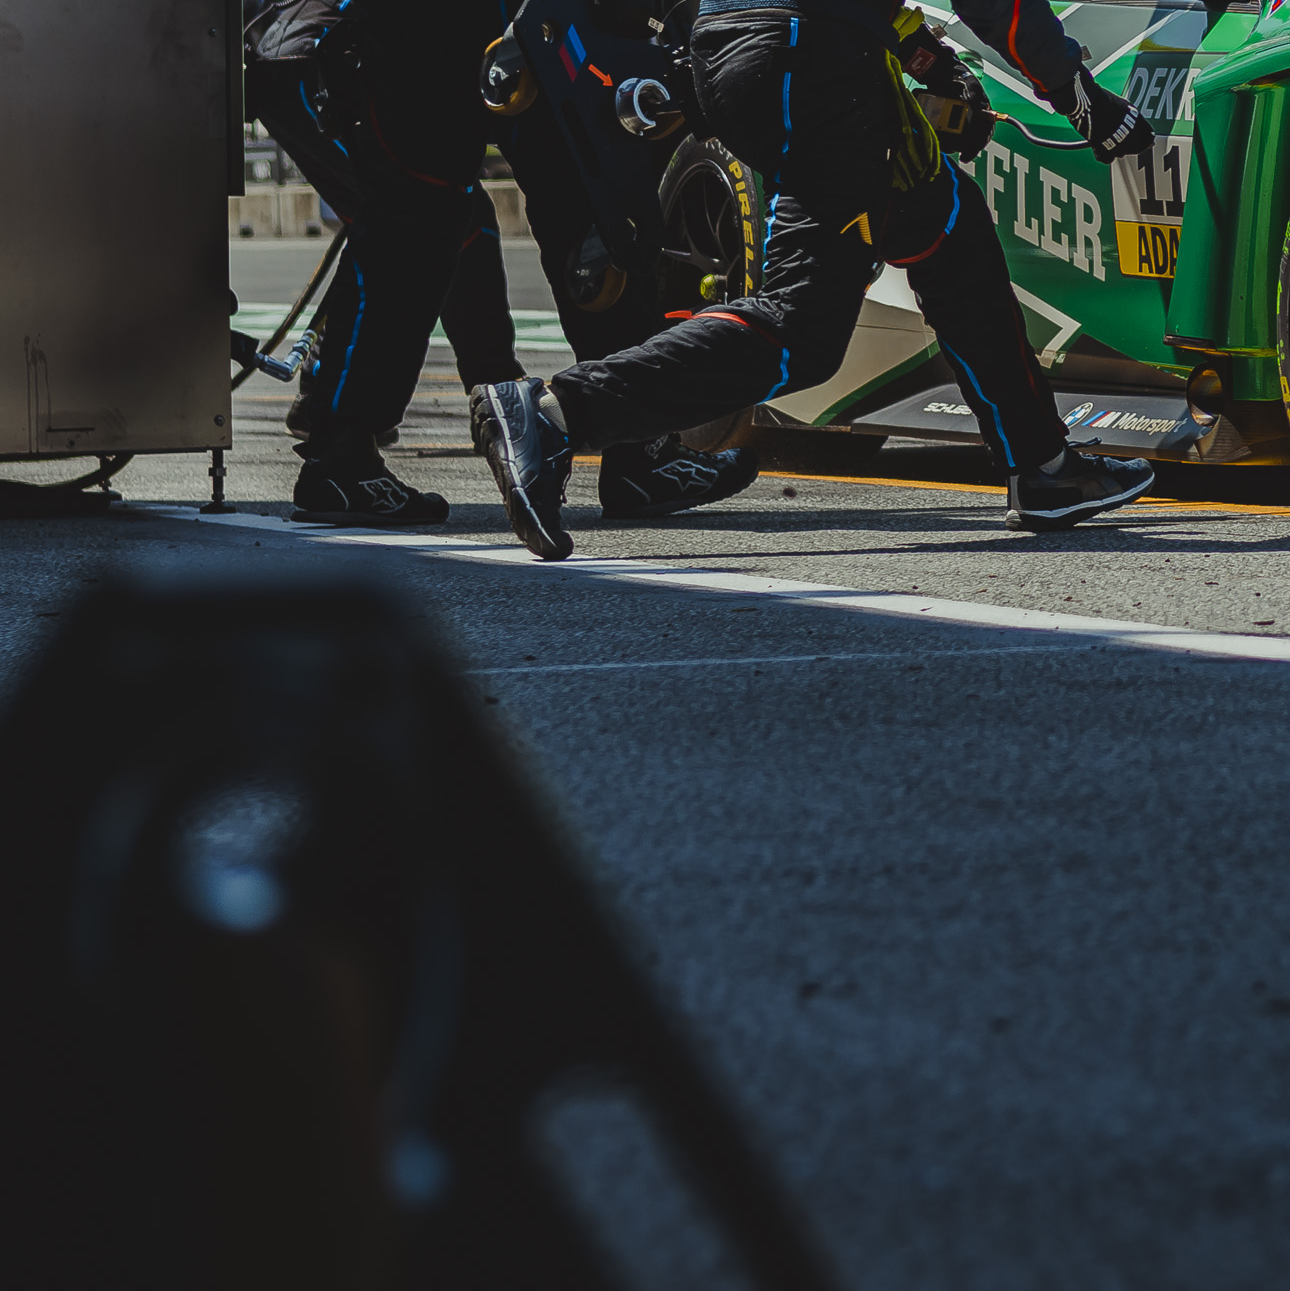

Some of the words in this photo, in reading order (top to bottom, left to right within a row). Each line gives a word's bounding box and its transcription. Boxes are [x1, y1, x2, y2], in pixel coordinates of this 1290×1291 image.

[1127, 67, 1202, 122] DEKR
[1137, 139, 1192, 218] 11
[728, 160, 754, 298] PIRELL
[1138, 225, 1181, 277] ADA
[1115, 411, 1187, 435] Motorsport
